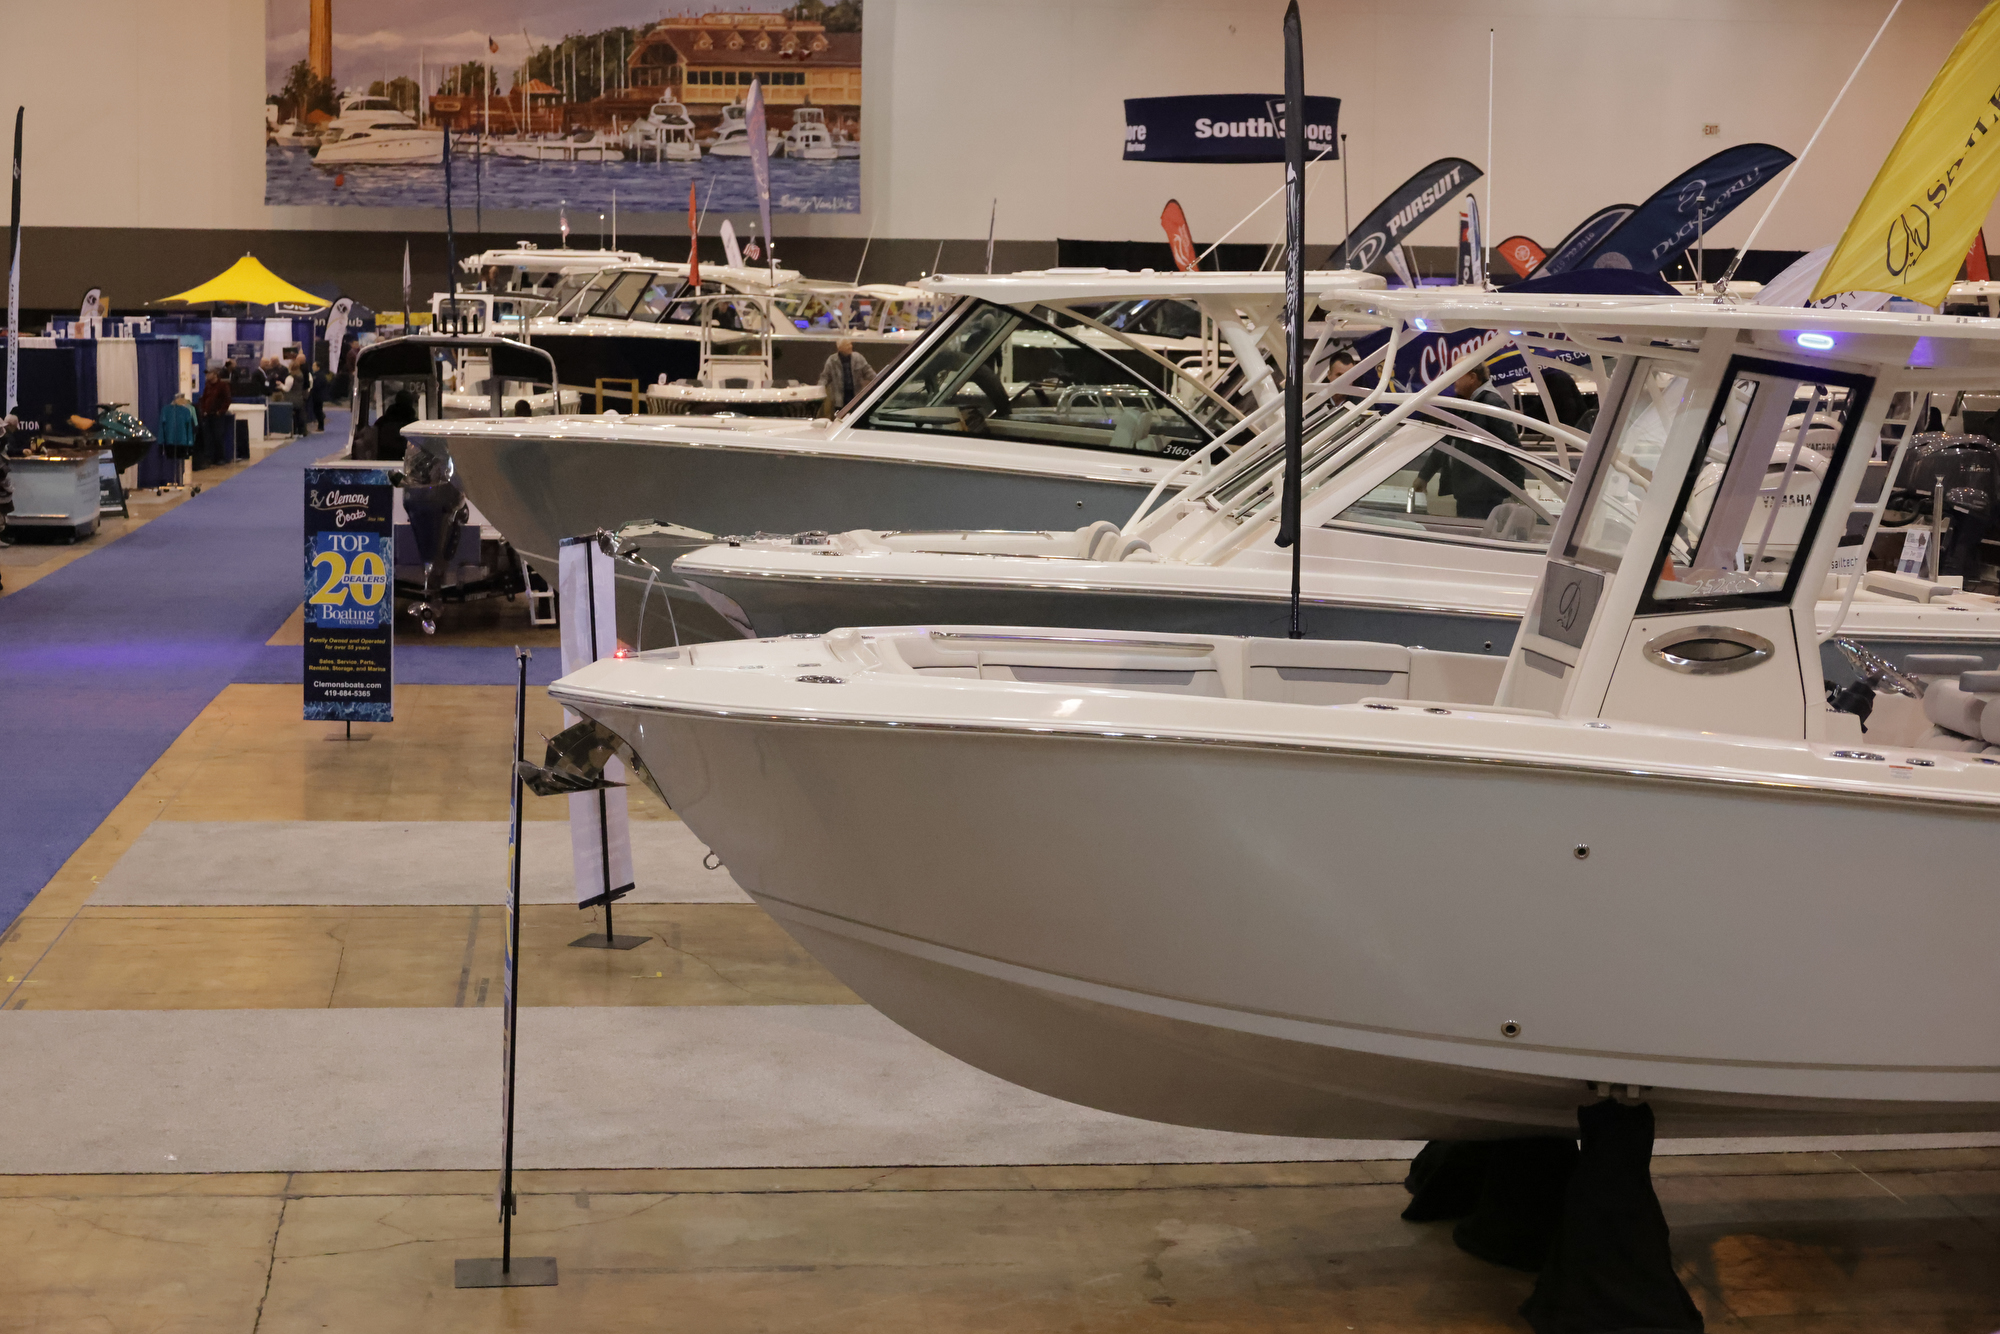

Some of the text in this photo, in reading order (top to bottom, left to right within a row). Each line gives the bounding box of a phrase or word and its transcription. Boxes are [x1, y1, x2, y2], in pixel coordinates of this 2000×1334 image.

[1194, 117, 1273, 139] South
[1386, 165, 1461, 237] PURSUIT
[1163, 444, 1196, 457] 316DC
[325, 489, 369, 507] Clemons
[335, 509, 367, 528] Boats
[328, 534, 370, 552] TOP
[309, 551, 387, 606] 20
[343, 575, 386, 584] DEALERS
[322, 604, 375, 625] Boating
[313, 681, 382, 689] Clemonsboats.com
[324, 689, 371, 697] 419-684-5365
